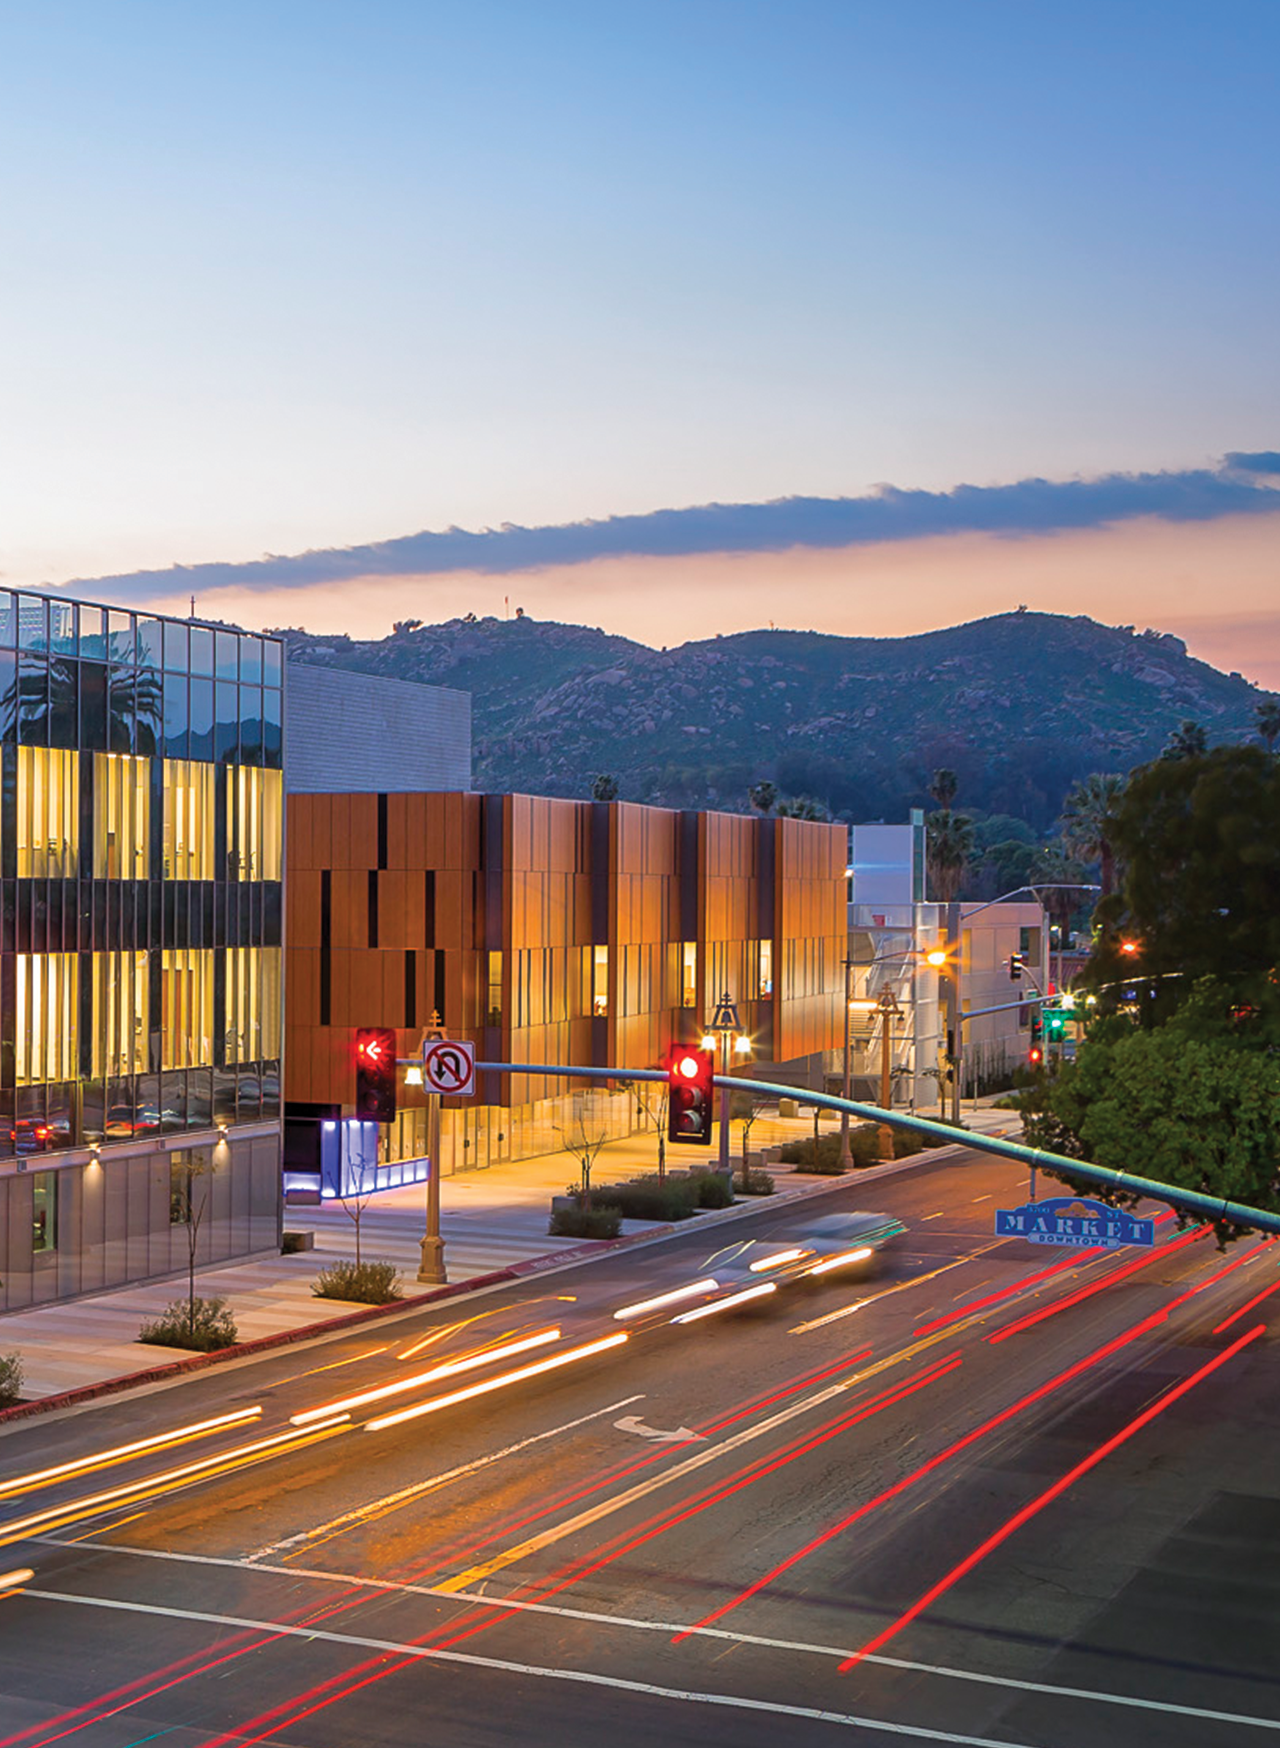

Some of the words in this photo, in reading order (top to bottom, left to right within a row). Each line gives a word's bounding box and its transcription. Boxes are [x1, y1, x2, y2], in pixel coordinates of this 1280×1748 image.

[1106, 1211, 1120, 1219] ST
[1004, 1215, 1145, 1239] MARKET
[1039, 1235, 1108, 1246] DOWNTOWN
